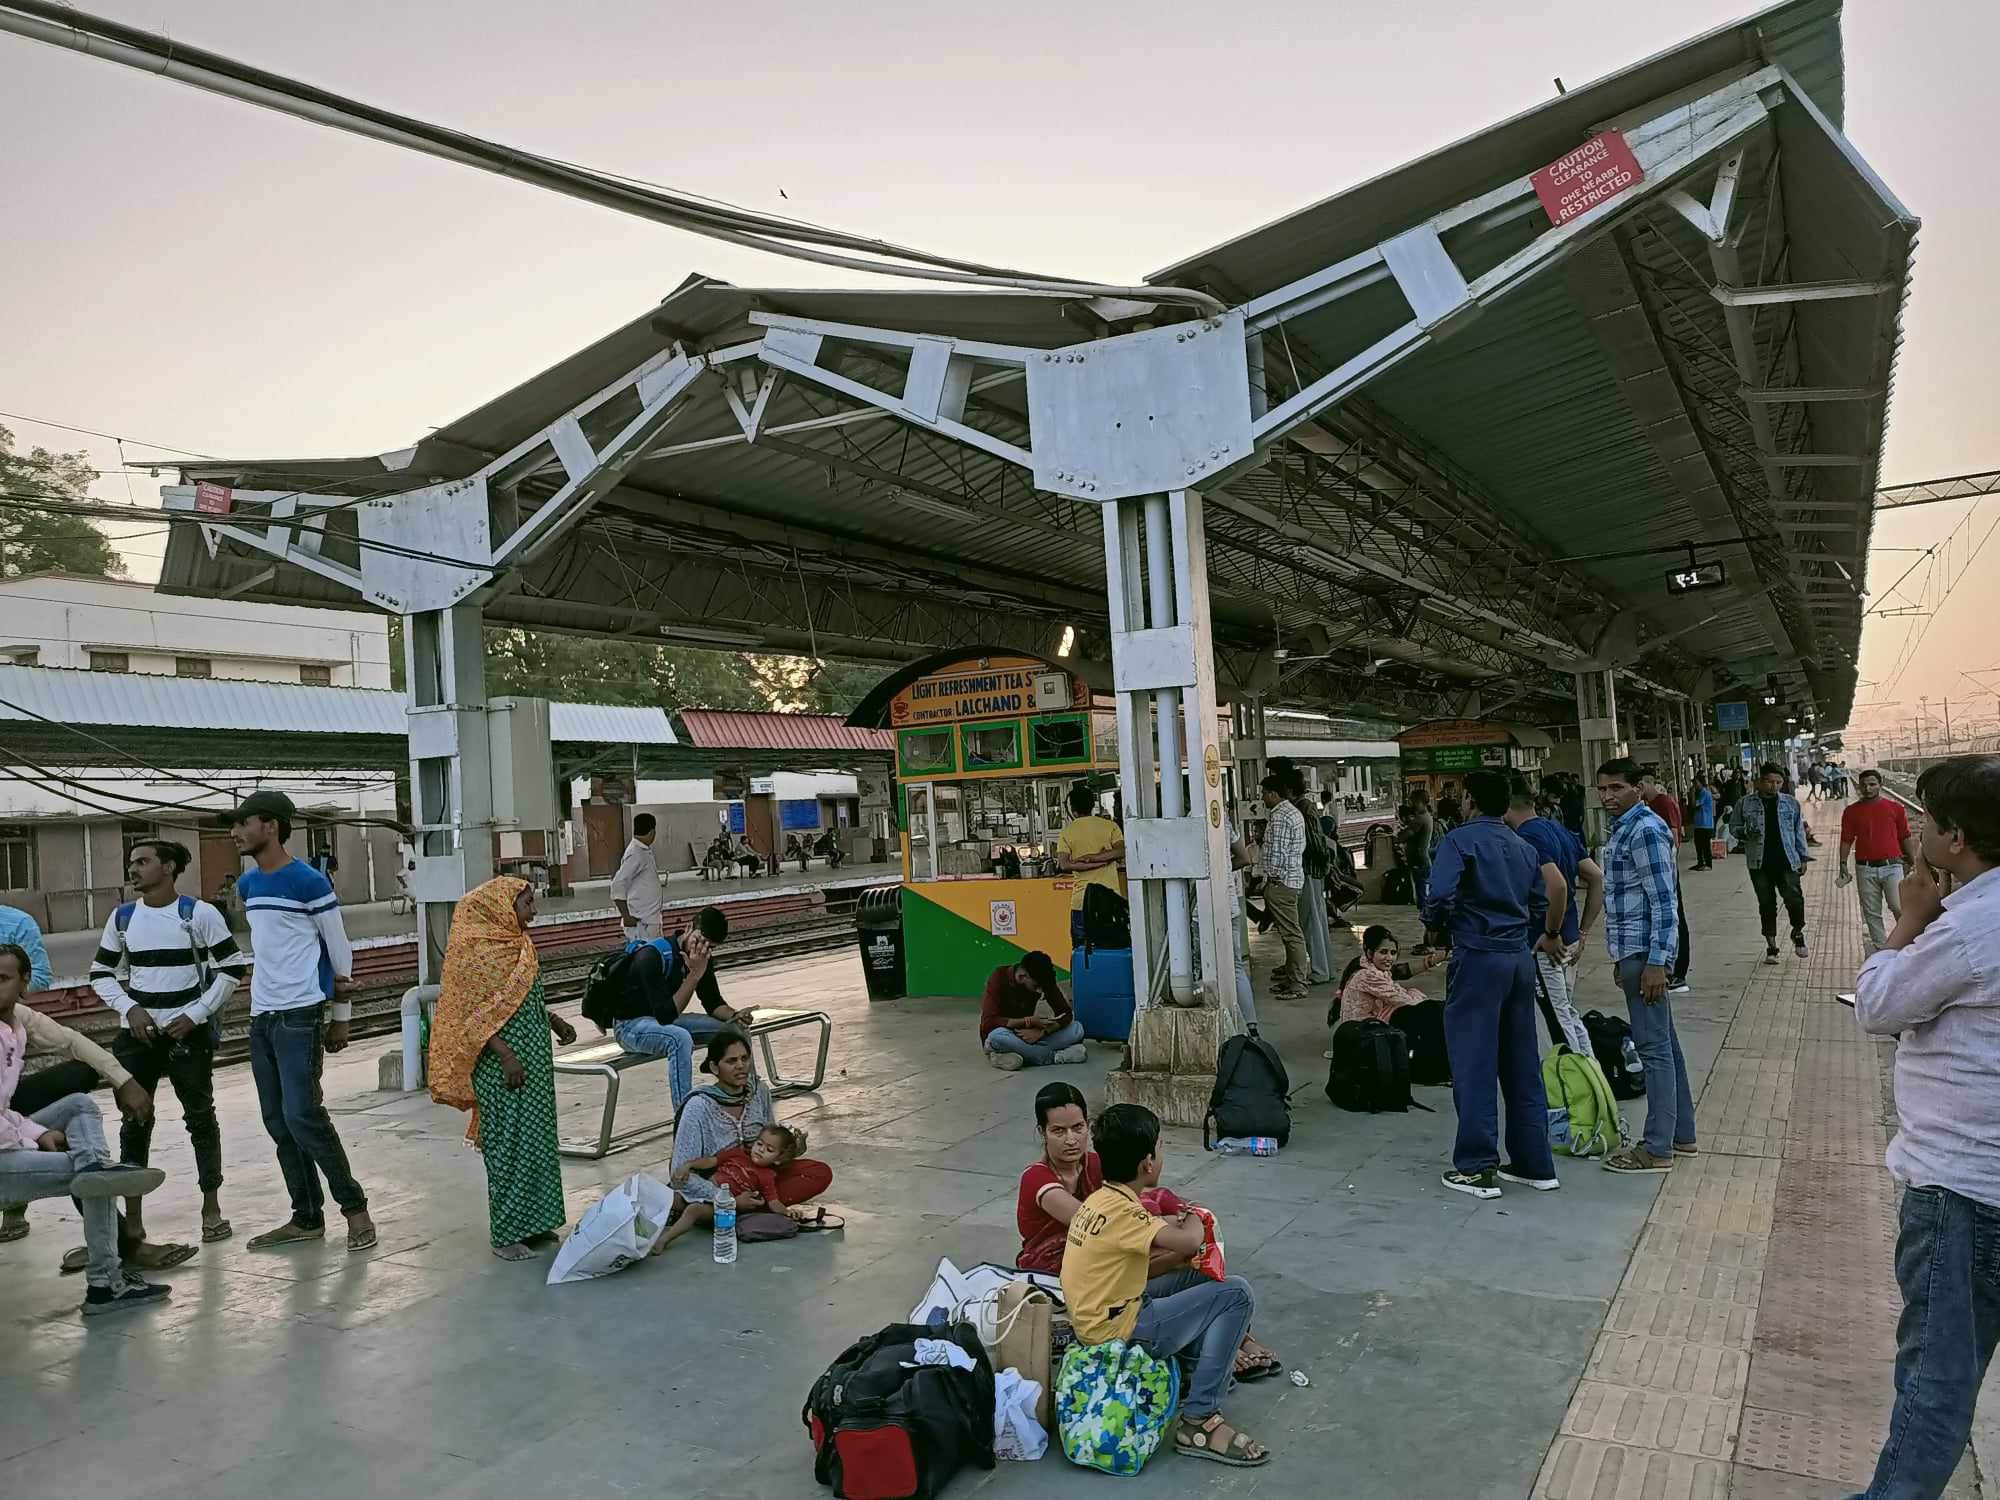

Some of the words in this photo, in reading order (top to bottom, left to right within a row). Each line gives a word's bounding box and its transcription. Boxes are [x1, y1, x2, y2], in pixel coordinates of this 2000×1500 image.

[1549, 138, 1605, 177] CAUTION
[1554, 148, 1609, 186] CLEARANCE
[1578, 170, 1593, 183] TO
[1559, 171, 1632, 220] RESTRICTED
[1560, 186, 1582, 205] OHE
[1582, 165, 1620, 194] NEARBY
[911, 681, 938, 700] LIGHT
[938, 674, 1003, 697] REFRESHMENT
[1004, 672, 1024, 690] TEA
[955, 694, 1022, 717] LALCHAND
